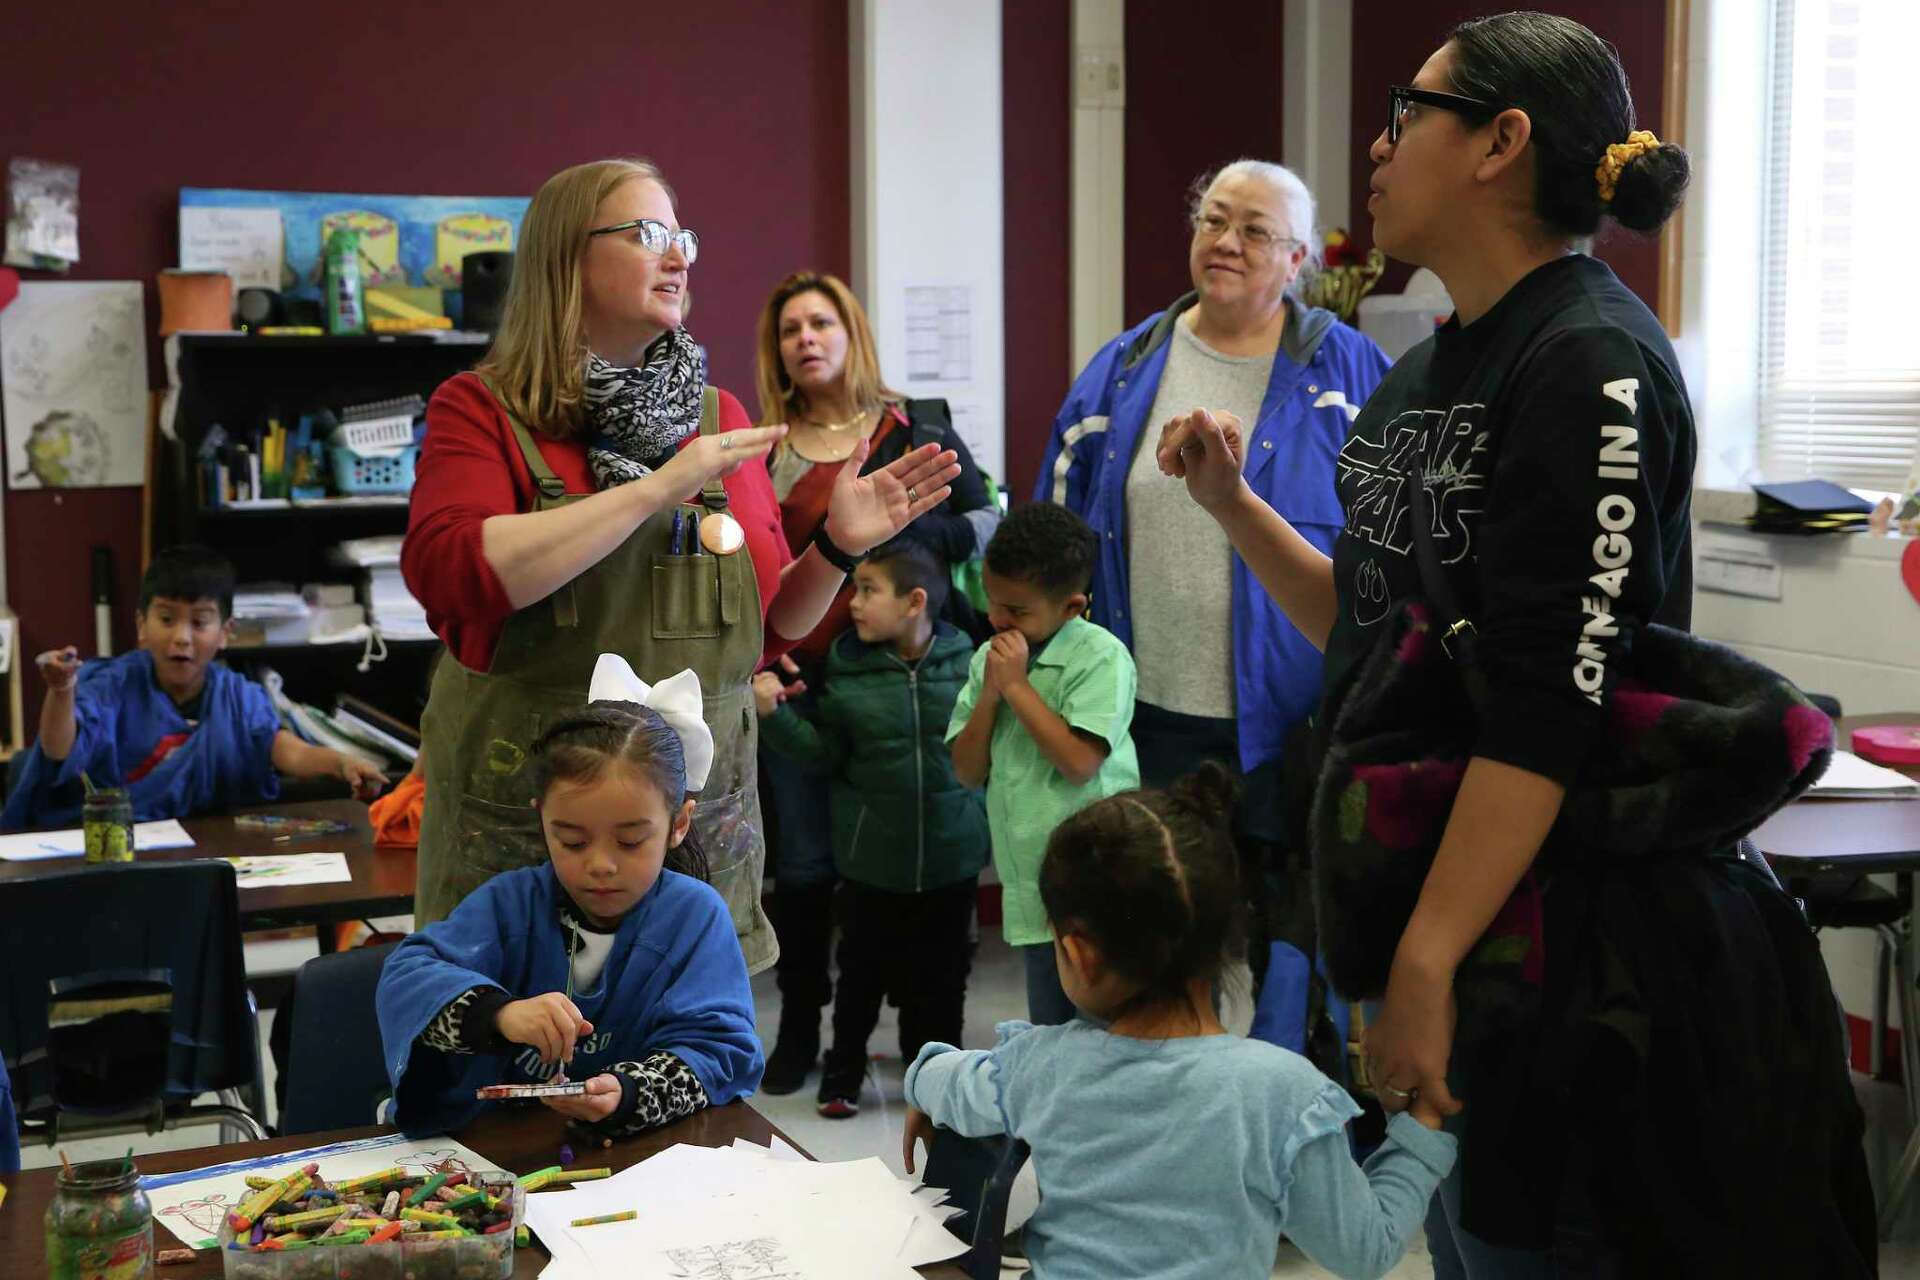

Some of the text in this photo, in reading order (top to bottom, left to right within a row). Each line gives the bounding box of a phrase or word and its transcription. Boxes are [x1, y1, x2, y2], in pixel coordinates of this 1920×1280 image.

[1602, 378, 1640, 415] A
[1598, 425, 1640, 480] IN
[1588, 494, 1635, 597] AGO
